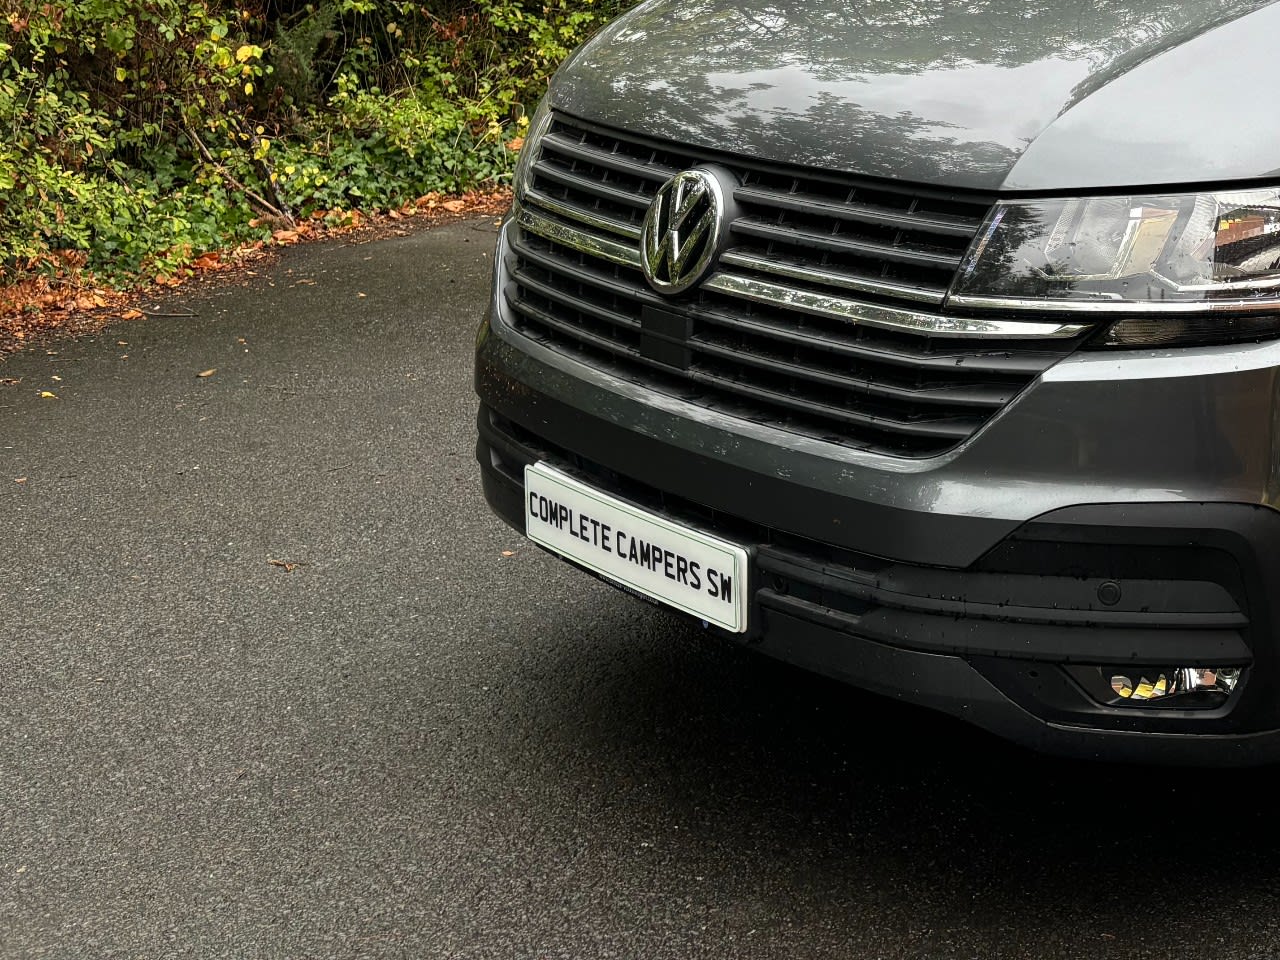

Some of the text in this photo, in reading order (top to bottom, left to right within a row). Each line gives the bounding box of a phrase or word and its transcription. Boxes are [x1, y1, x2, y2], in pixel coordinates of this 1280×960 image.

[529, 491, 612, 553] COMPLETE
[616, 531, 701, 591] CAMPERS
[706, 568, 732, 604] SW
